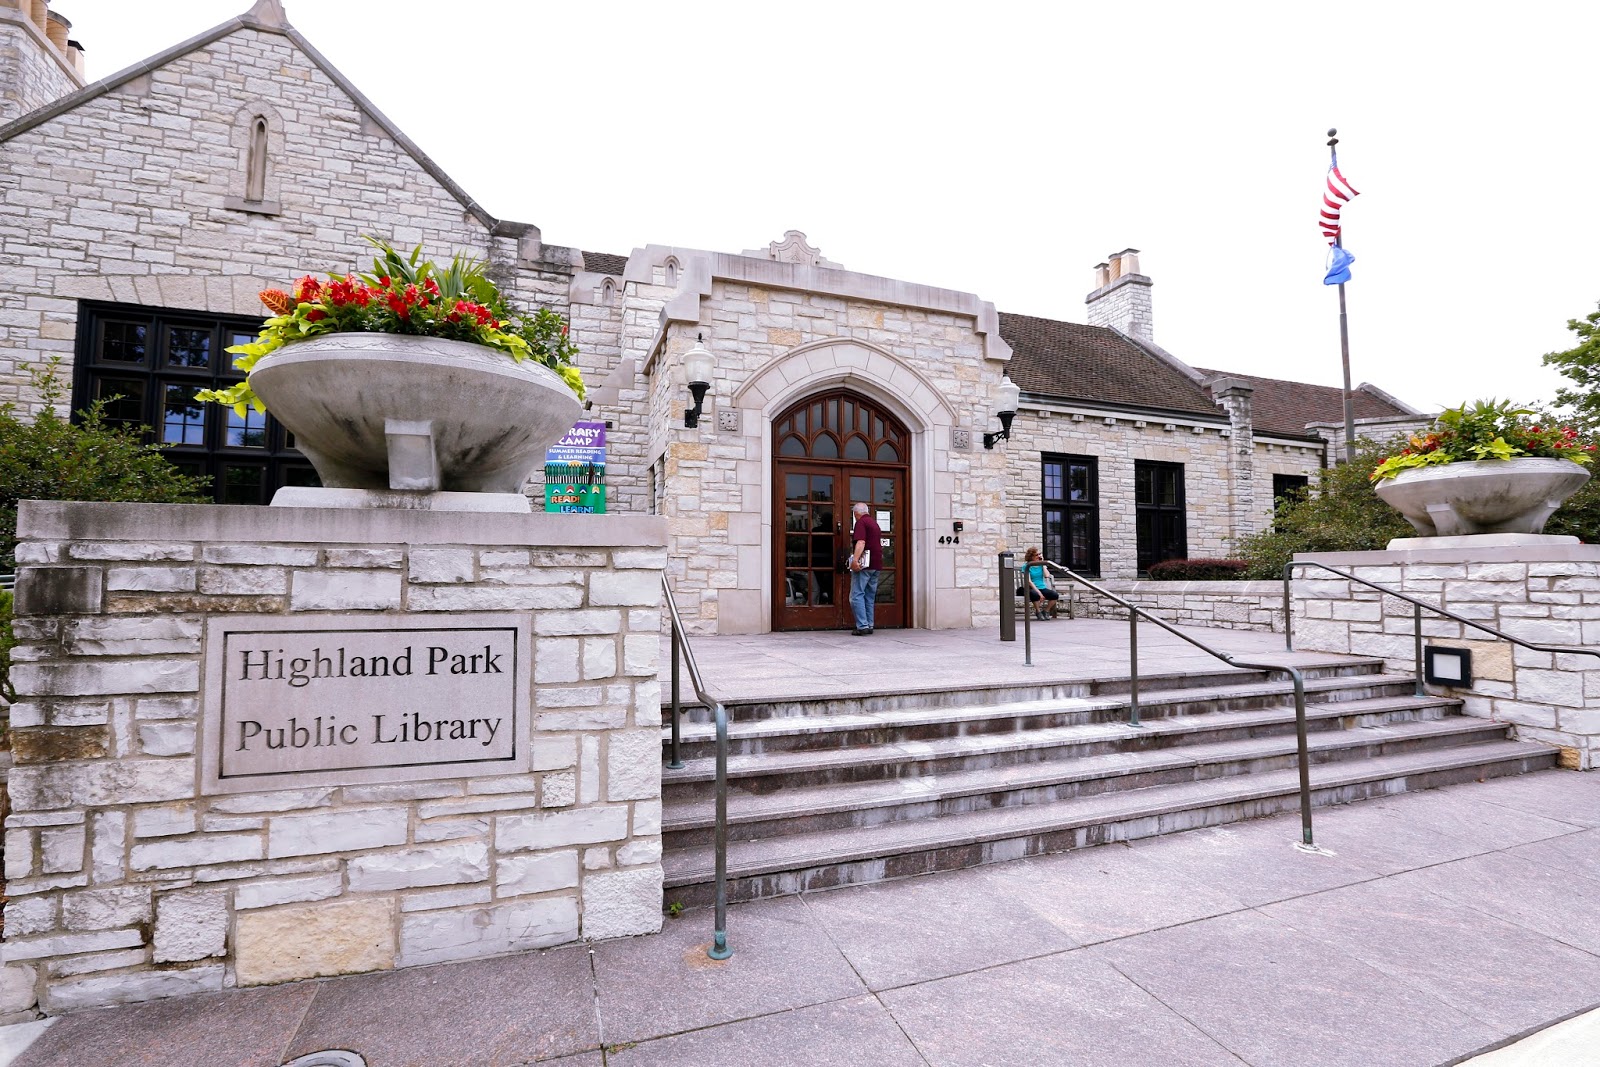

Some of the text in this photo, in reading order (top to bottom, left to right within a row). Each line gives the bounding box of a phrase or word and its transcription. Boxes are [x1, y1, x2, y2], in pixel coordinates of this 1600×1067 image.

[568, 428, 600, 437] RARY
[558, 437, 592, 445] CAMP
[560, 505, 594, 513] LEARN!
[938, 535, 960, 544] 494
[238, 645, 503, 687] Highland Park
[235, 712, 502, 751] Public Library
